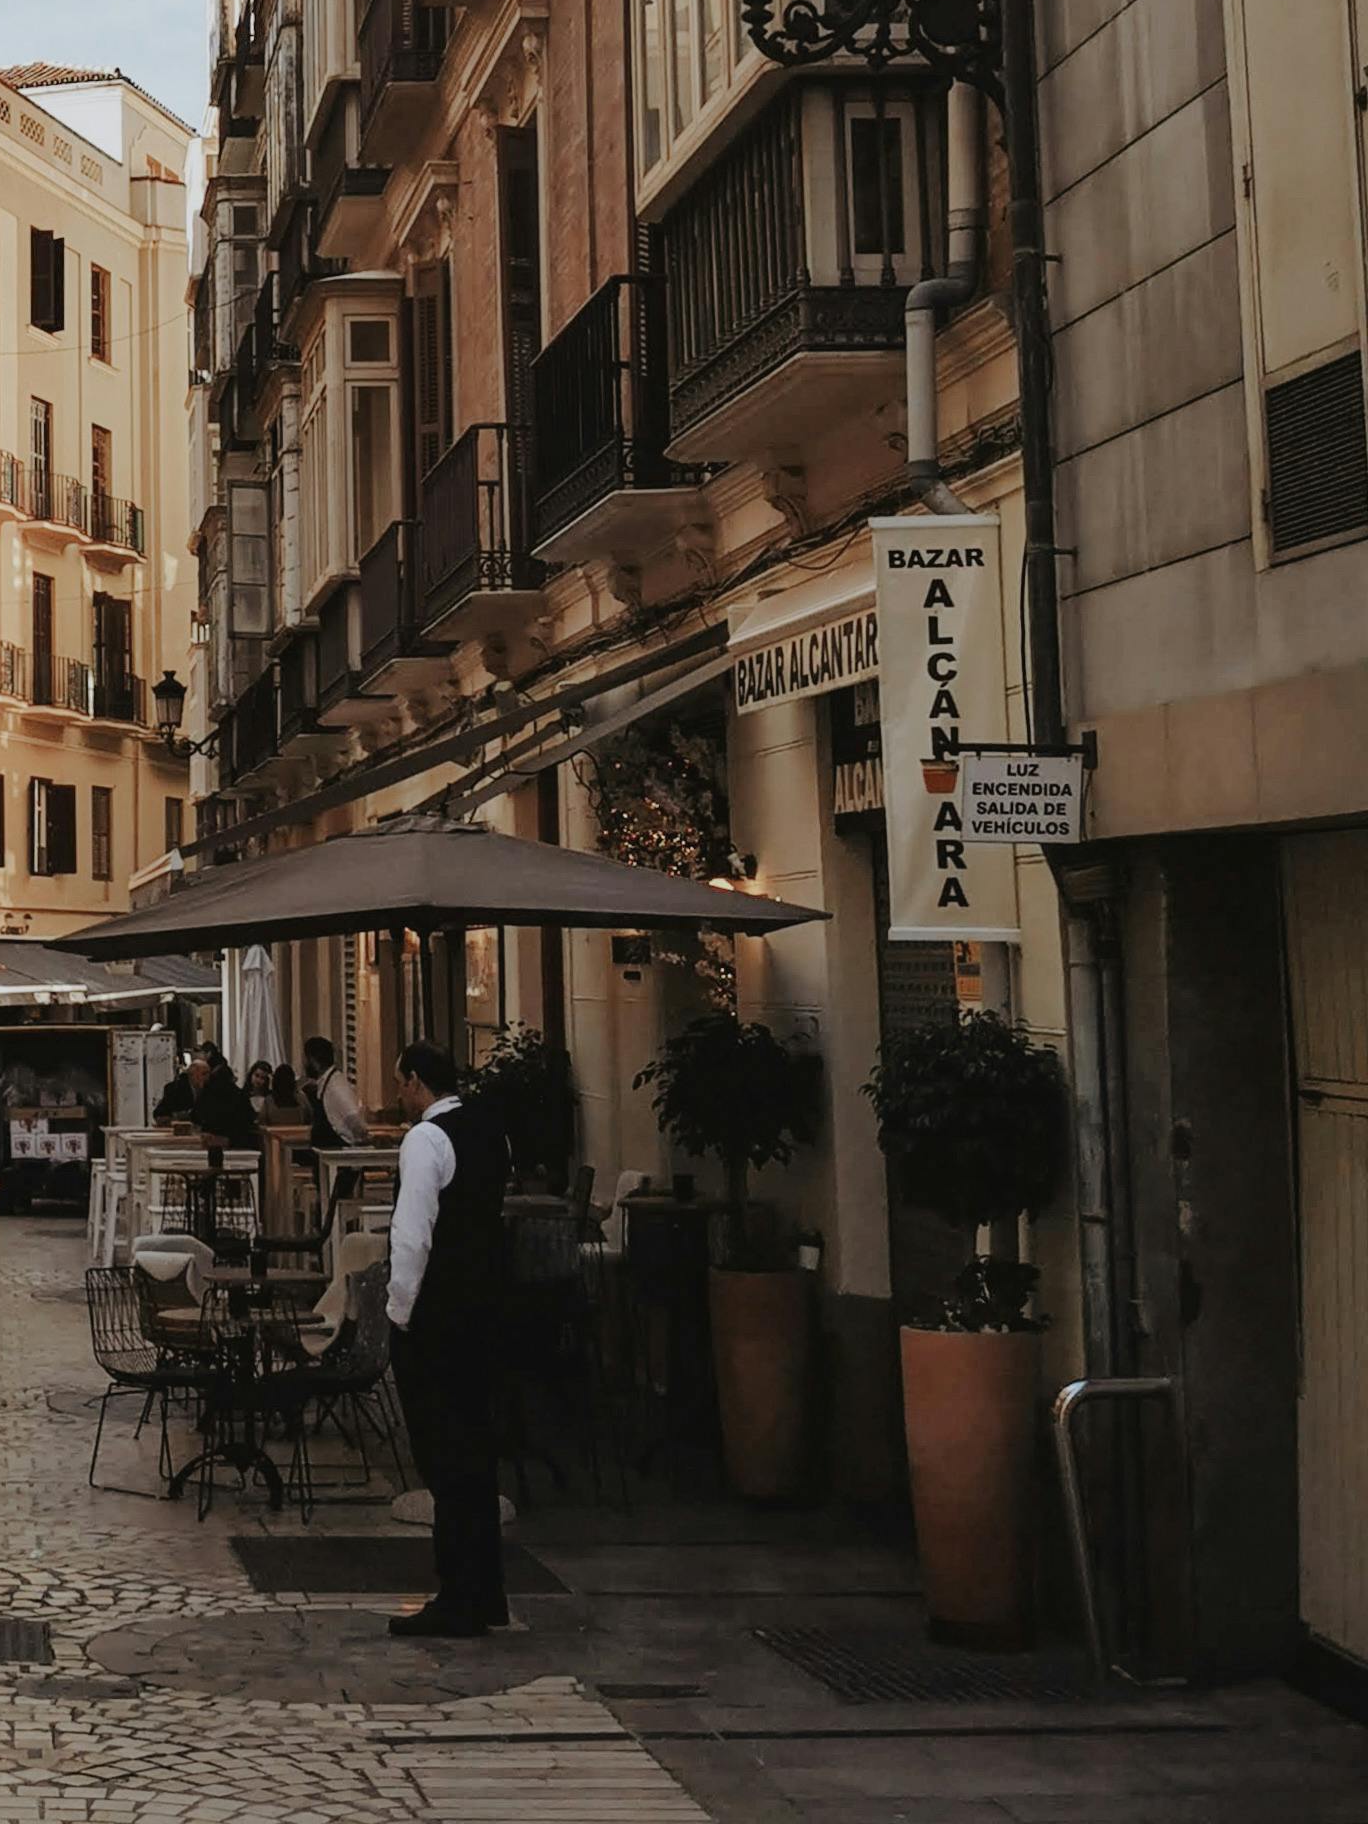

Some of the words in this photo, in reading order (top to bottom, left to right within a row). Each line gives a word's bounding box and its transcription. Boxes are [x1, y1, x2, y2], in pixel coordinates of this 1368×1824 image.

[888, 548, 984, 569] BAZAR
[737, 646, 786, 707] BAZAR
[923, 578, 969, 908] ALCÁNARA
[1006, 763, 1040, 777] LUZ
[972, 782, 1073, 797] ENCENDIDA
[976, 801, 1038, 815] SALIDA
[1043, 802, 1067, 816] DE
[972, 817, 1070, 835] VEHÍCULOS
